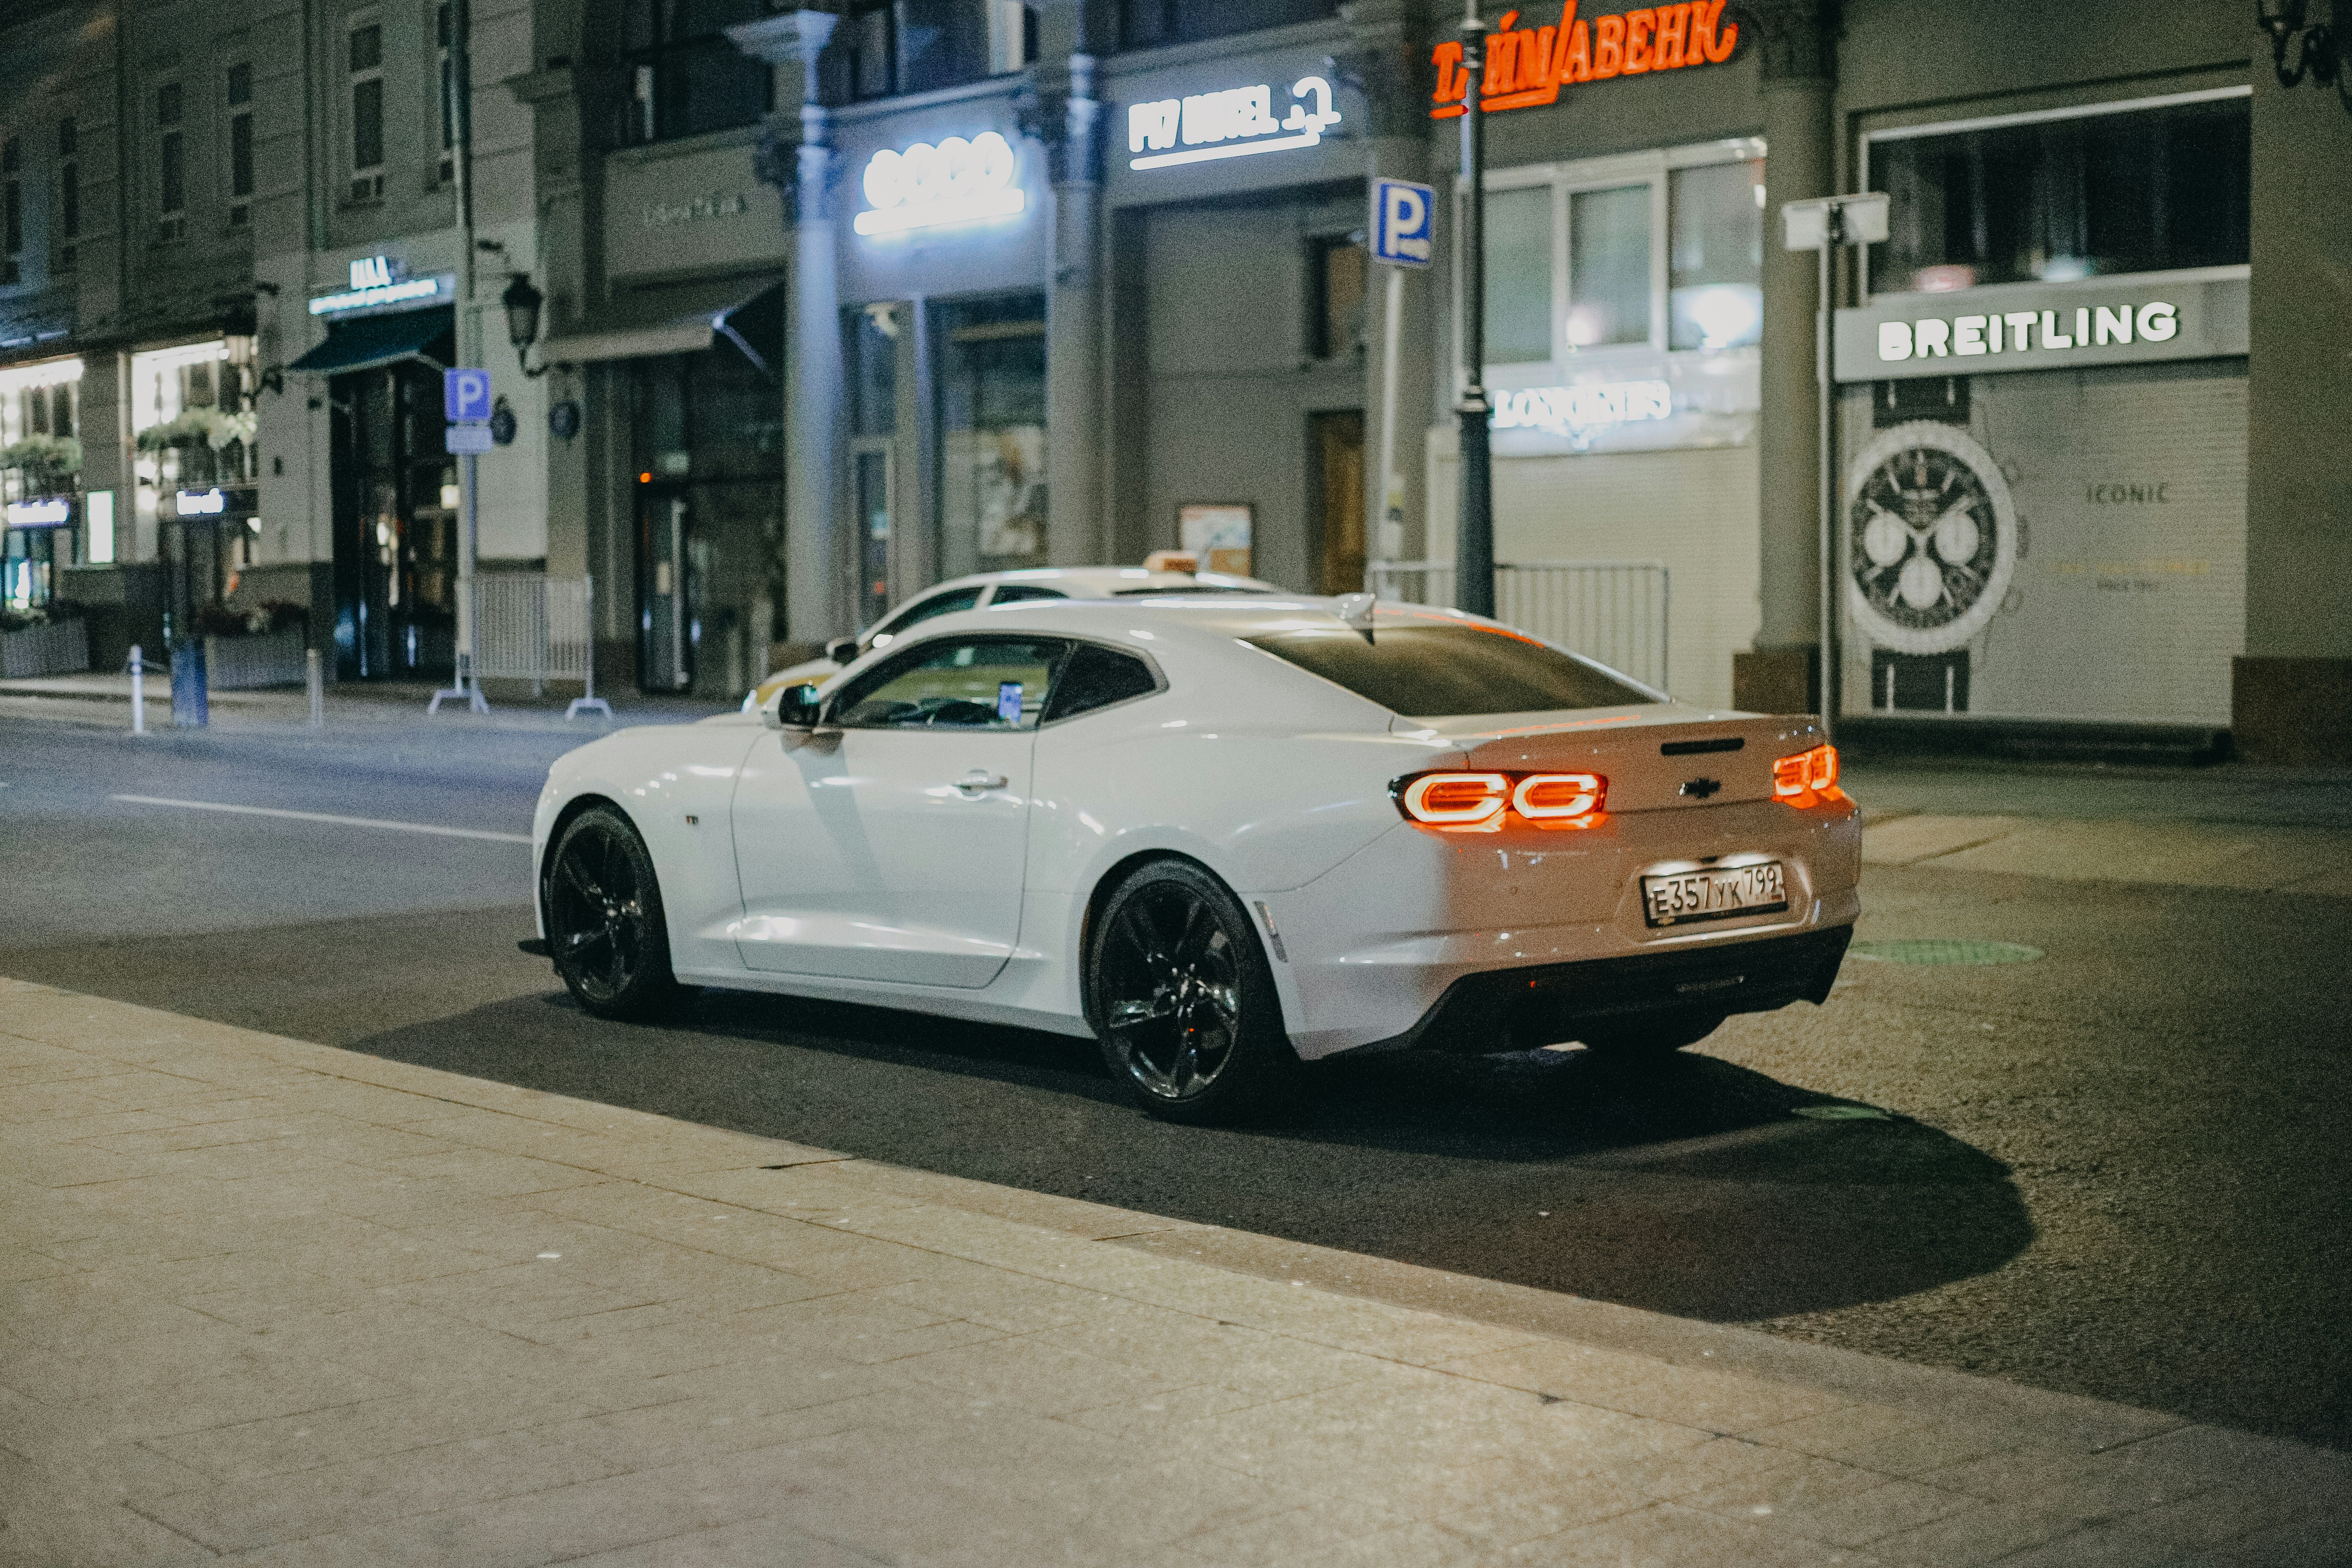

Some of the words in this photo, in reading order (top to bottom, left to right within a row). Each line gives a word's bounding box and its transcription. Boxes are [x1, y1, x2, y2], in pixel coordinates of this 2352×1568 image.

[1386, 188, 1426, 258] P
[1878, 302, 2177, 361] BREITLING
[458, 375, 482, 415] P
[2086, 482, 2170, 504] ICONIC
[1744, 867, 1776, 895] 799
